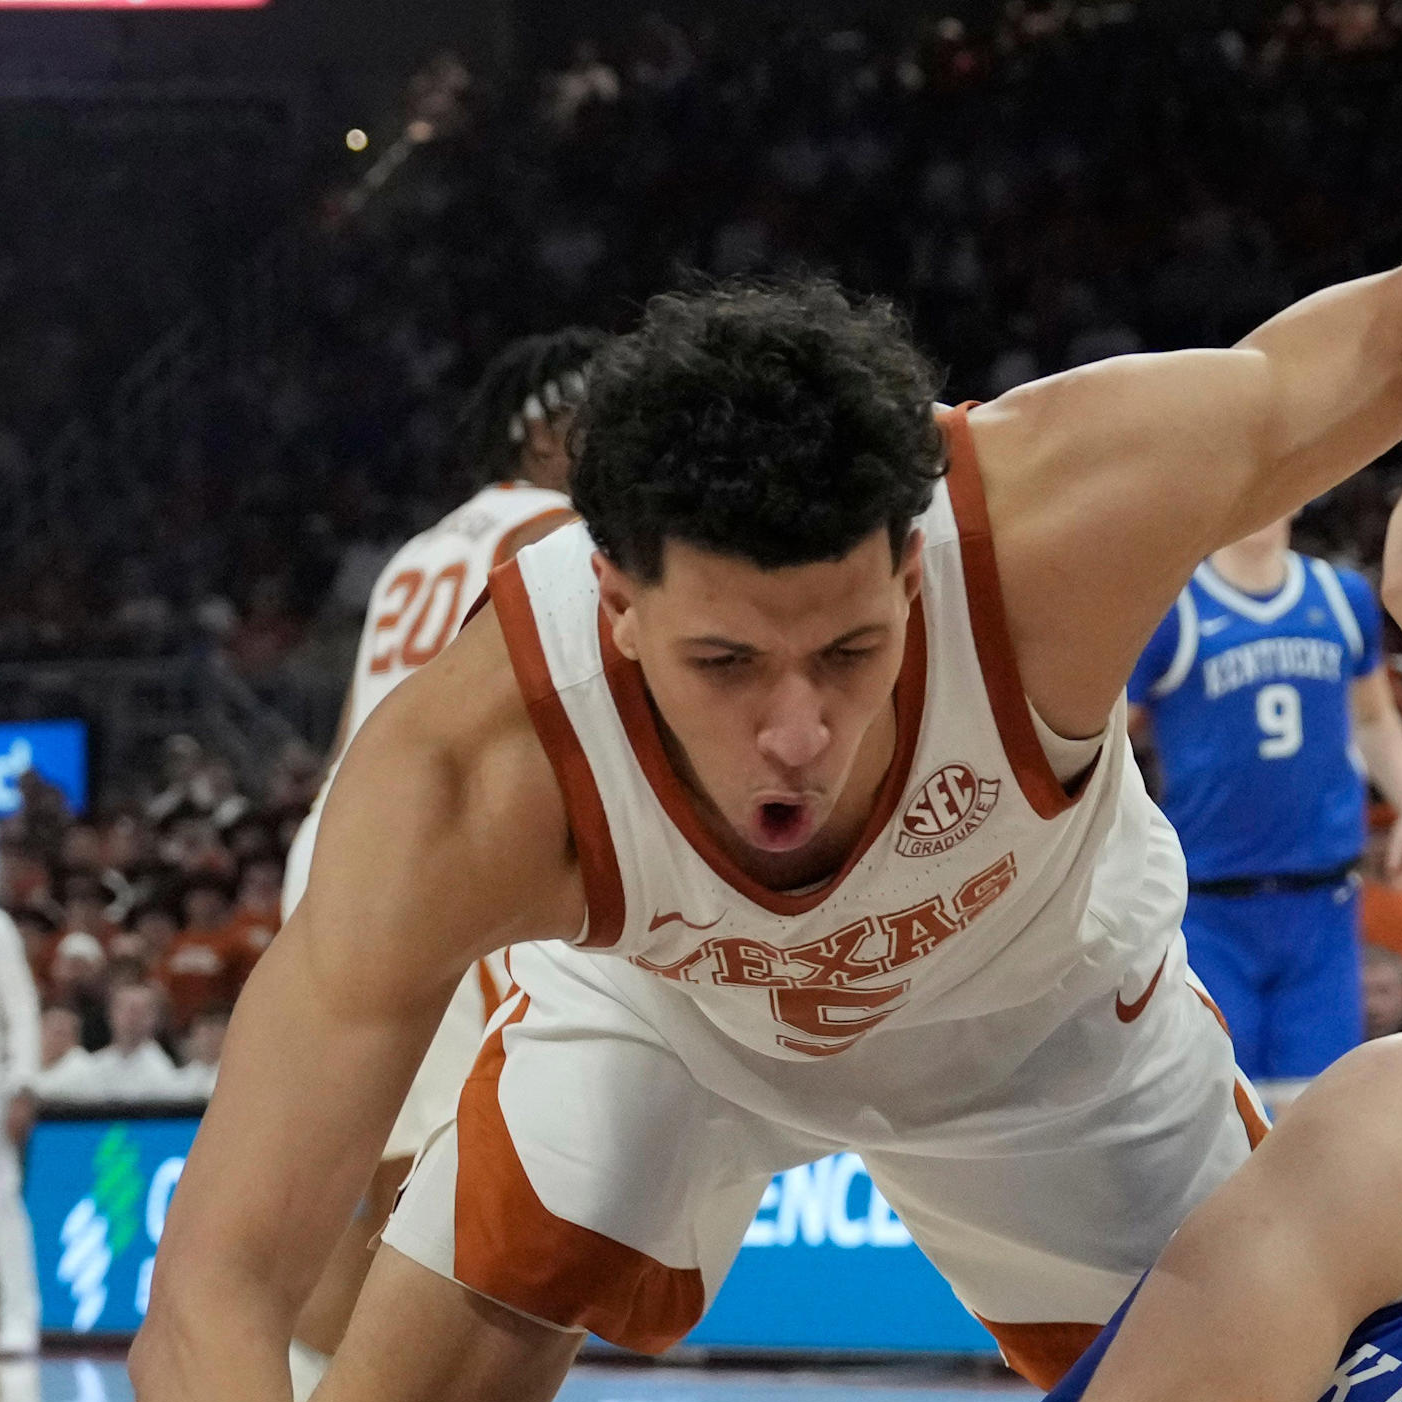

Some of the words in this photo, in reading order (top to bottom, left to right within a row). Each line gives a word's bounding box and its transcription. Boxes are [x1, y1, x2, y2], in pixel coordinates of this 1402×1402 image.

[369, 559, 468, 676] 20
[1254, 683, 1304, 762] 9
[906, 767, 974, 833] SEC
[910, 801, 991, 856] GRADUATE
